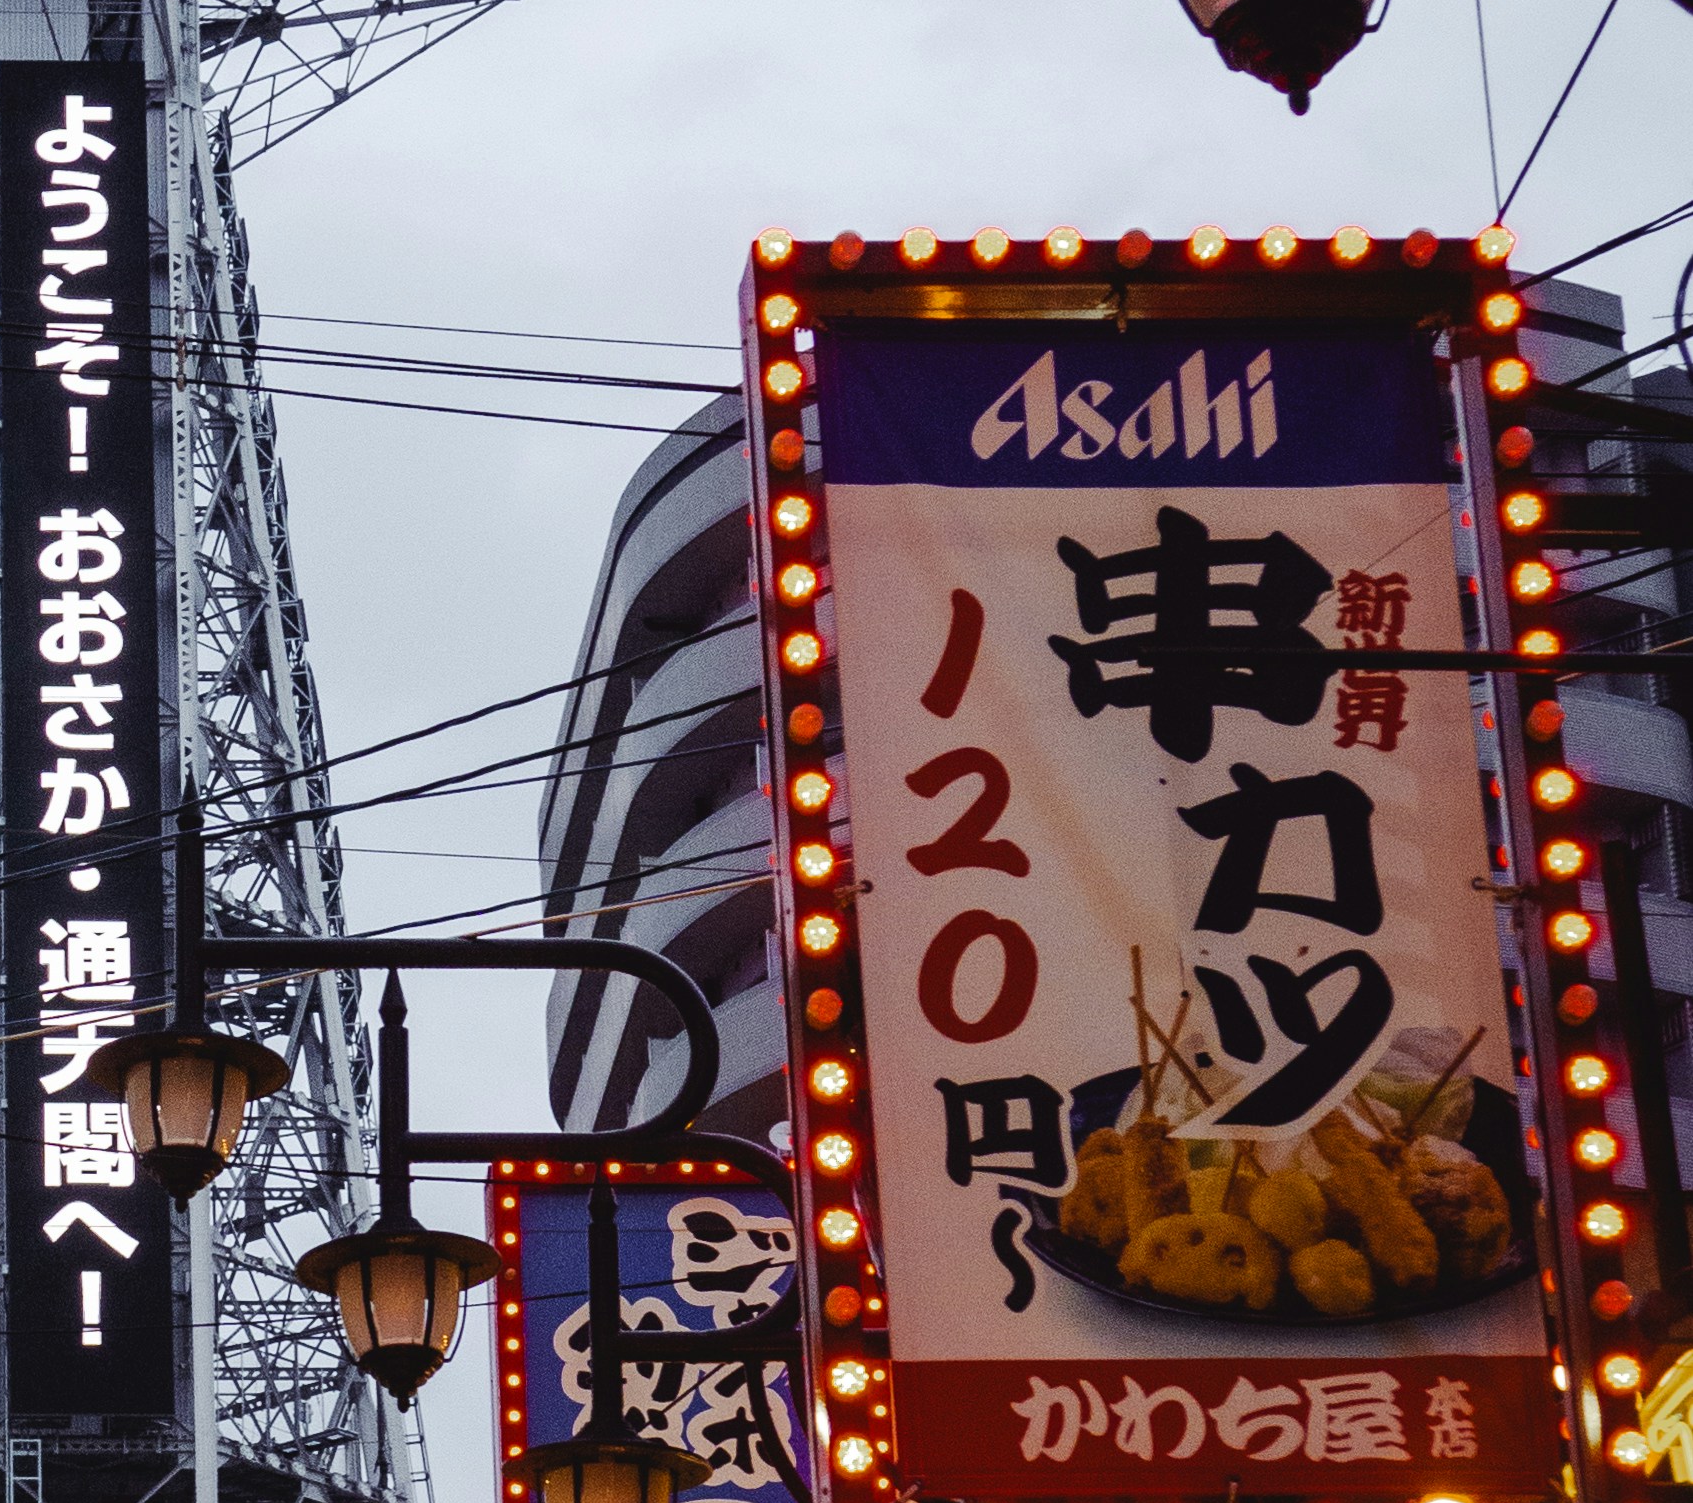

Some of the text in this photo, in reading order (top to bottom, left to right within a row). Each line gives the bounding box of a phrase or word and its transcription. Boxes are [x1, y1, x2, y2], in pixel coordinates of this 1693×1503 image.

[969, 349, 1281, 462] Asahi
[1047, 504, 1396, 1130] 串カツ
[1010, 1371, 1413, 1464] かわち屋
[1424, 1376, 1480, 1460] 本店
